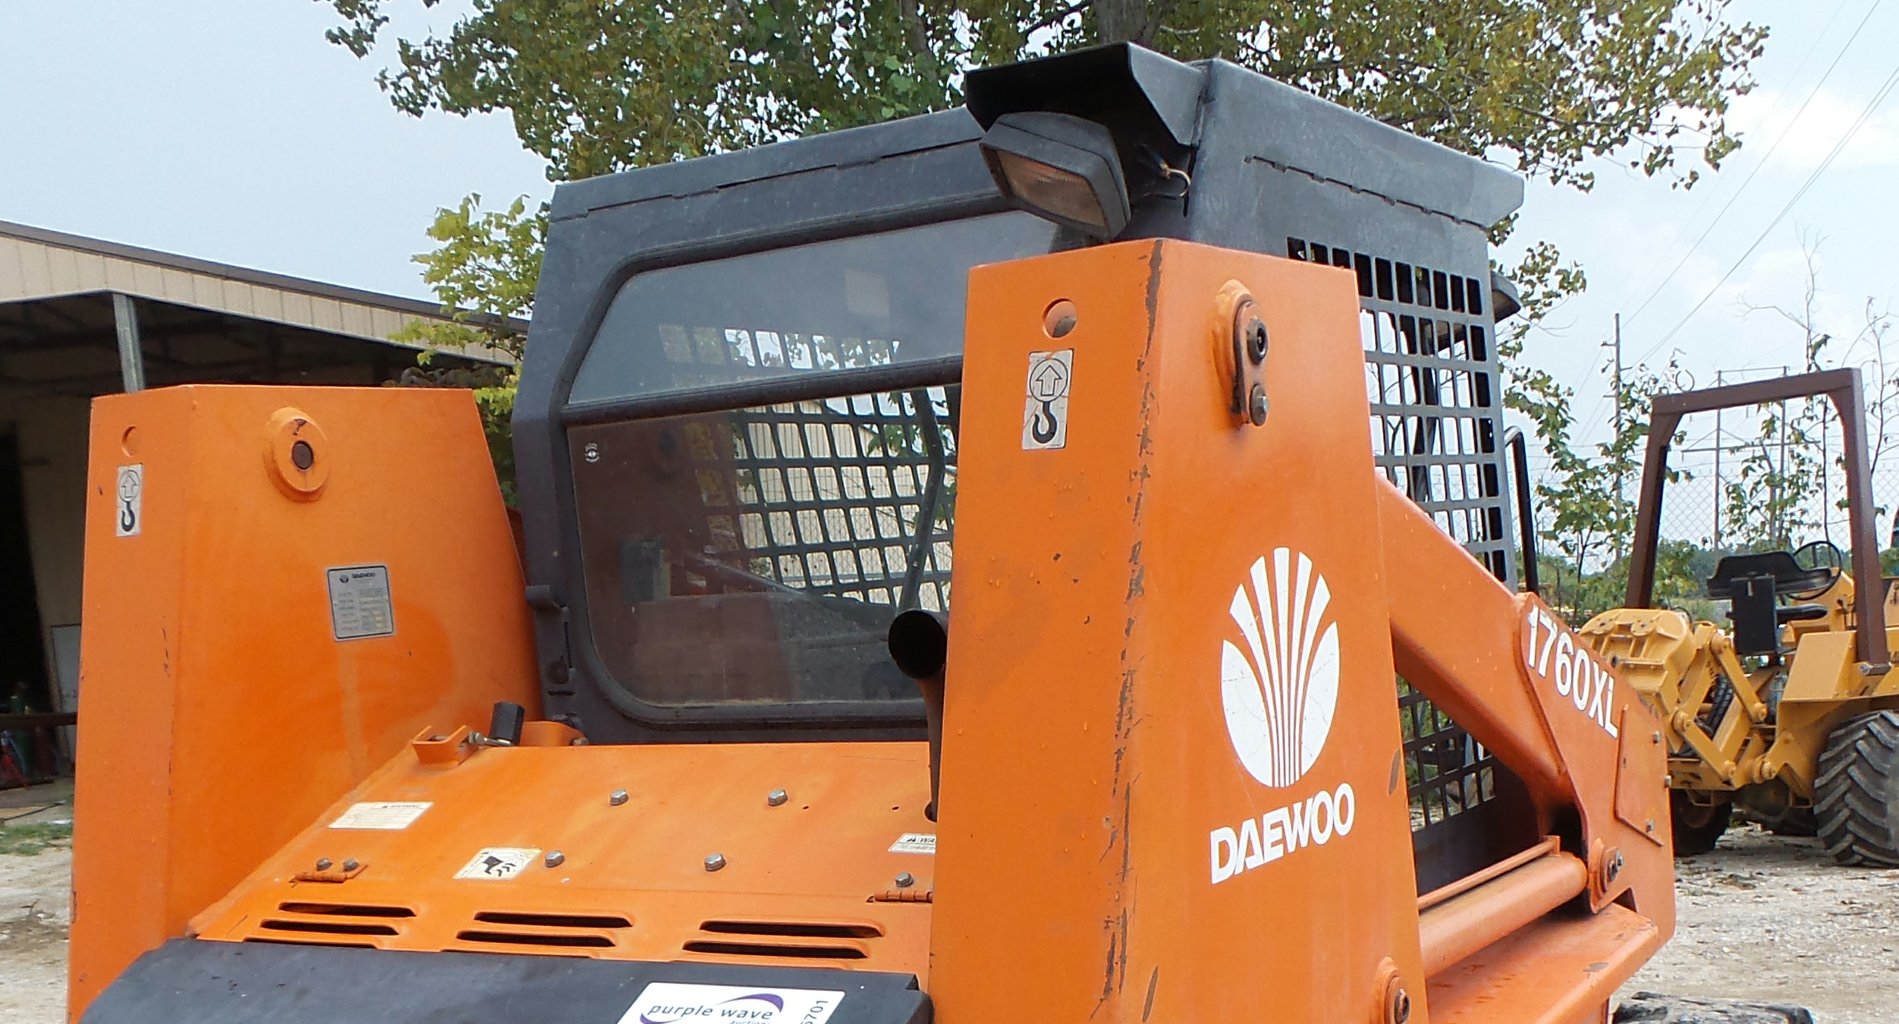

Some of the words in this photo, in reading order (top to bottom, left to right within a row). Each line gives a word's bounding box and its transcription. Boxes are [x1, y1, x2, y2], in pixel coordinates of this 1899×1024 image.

[1528, 603, 1618, 739] 1760XL
[1209, 782, 1355, 885] DAEWOO
[647, 1003, 713, 1018] purple
[720, 1007, 773, 1020] wave
